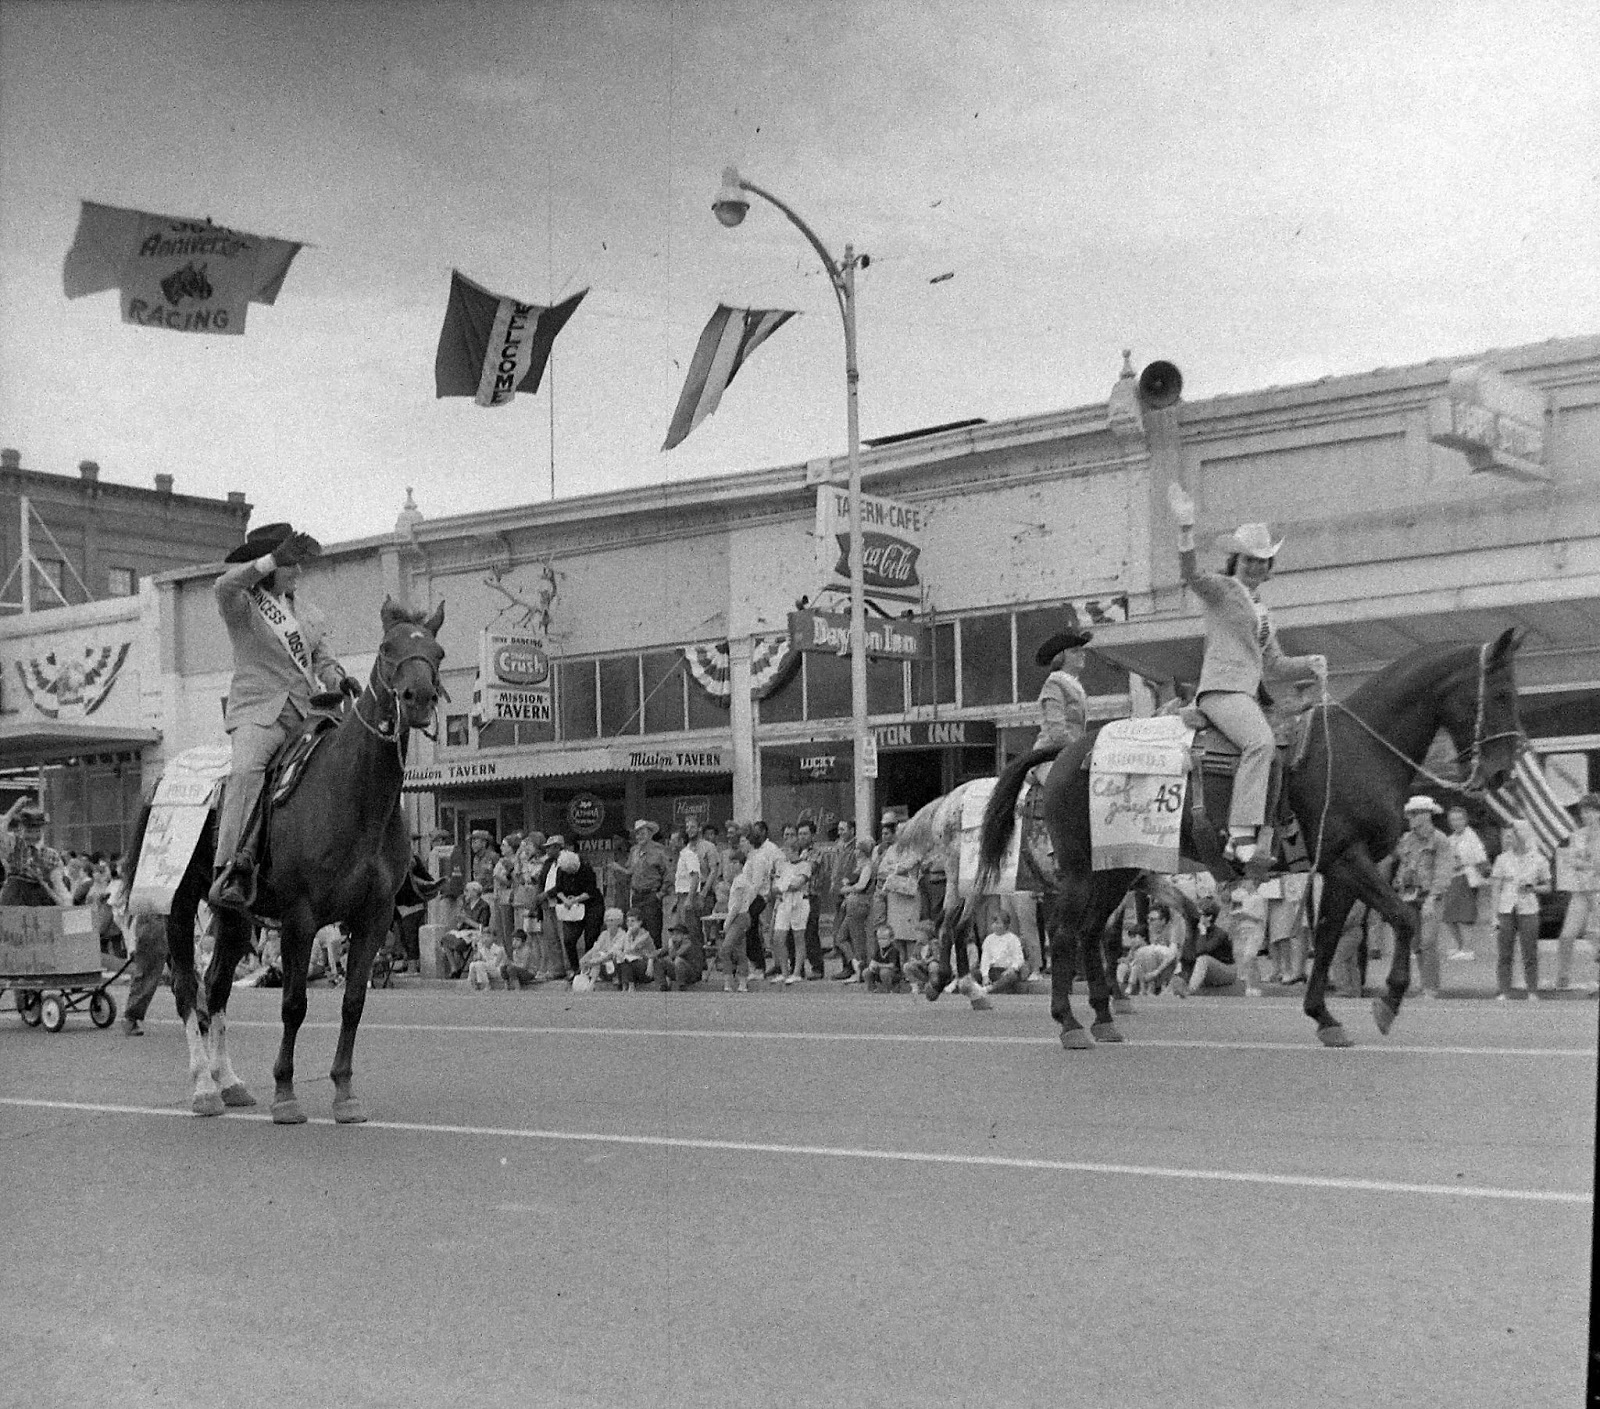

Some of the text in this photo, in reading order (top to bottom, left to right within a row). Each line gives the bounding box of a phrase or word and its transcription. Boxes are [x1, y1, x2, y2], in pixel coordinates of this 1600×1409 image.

[129, 299, 229, 330] RACING
[834, 494, 921, 532] TAERN CAFE
[812, 616, 917, 657] Dayn Inn
[500, 651, 544, 674] Crush
[500, 692, 543, 704] MISSION
[495, 703, 550, 719] TAVERN
[877, 722, 965, 746] TON INN
[628, 751, 721, 767] Mission TAVERN
[800, 755, 837, 770] LUCKY
[448, 763, 497, 778] TAVERN
[576, 838, 612, 851] TAVER
